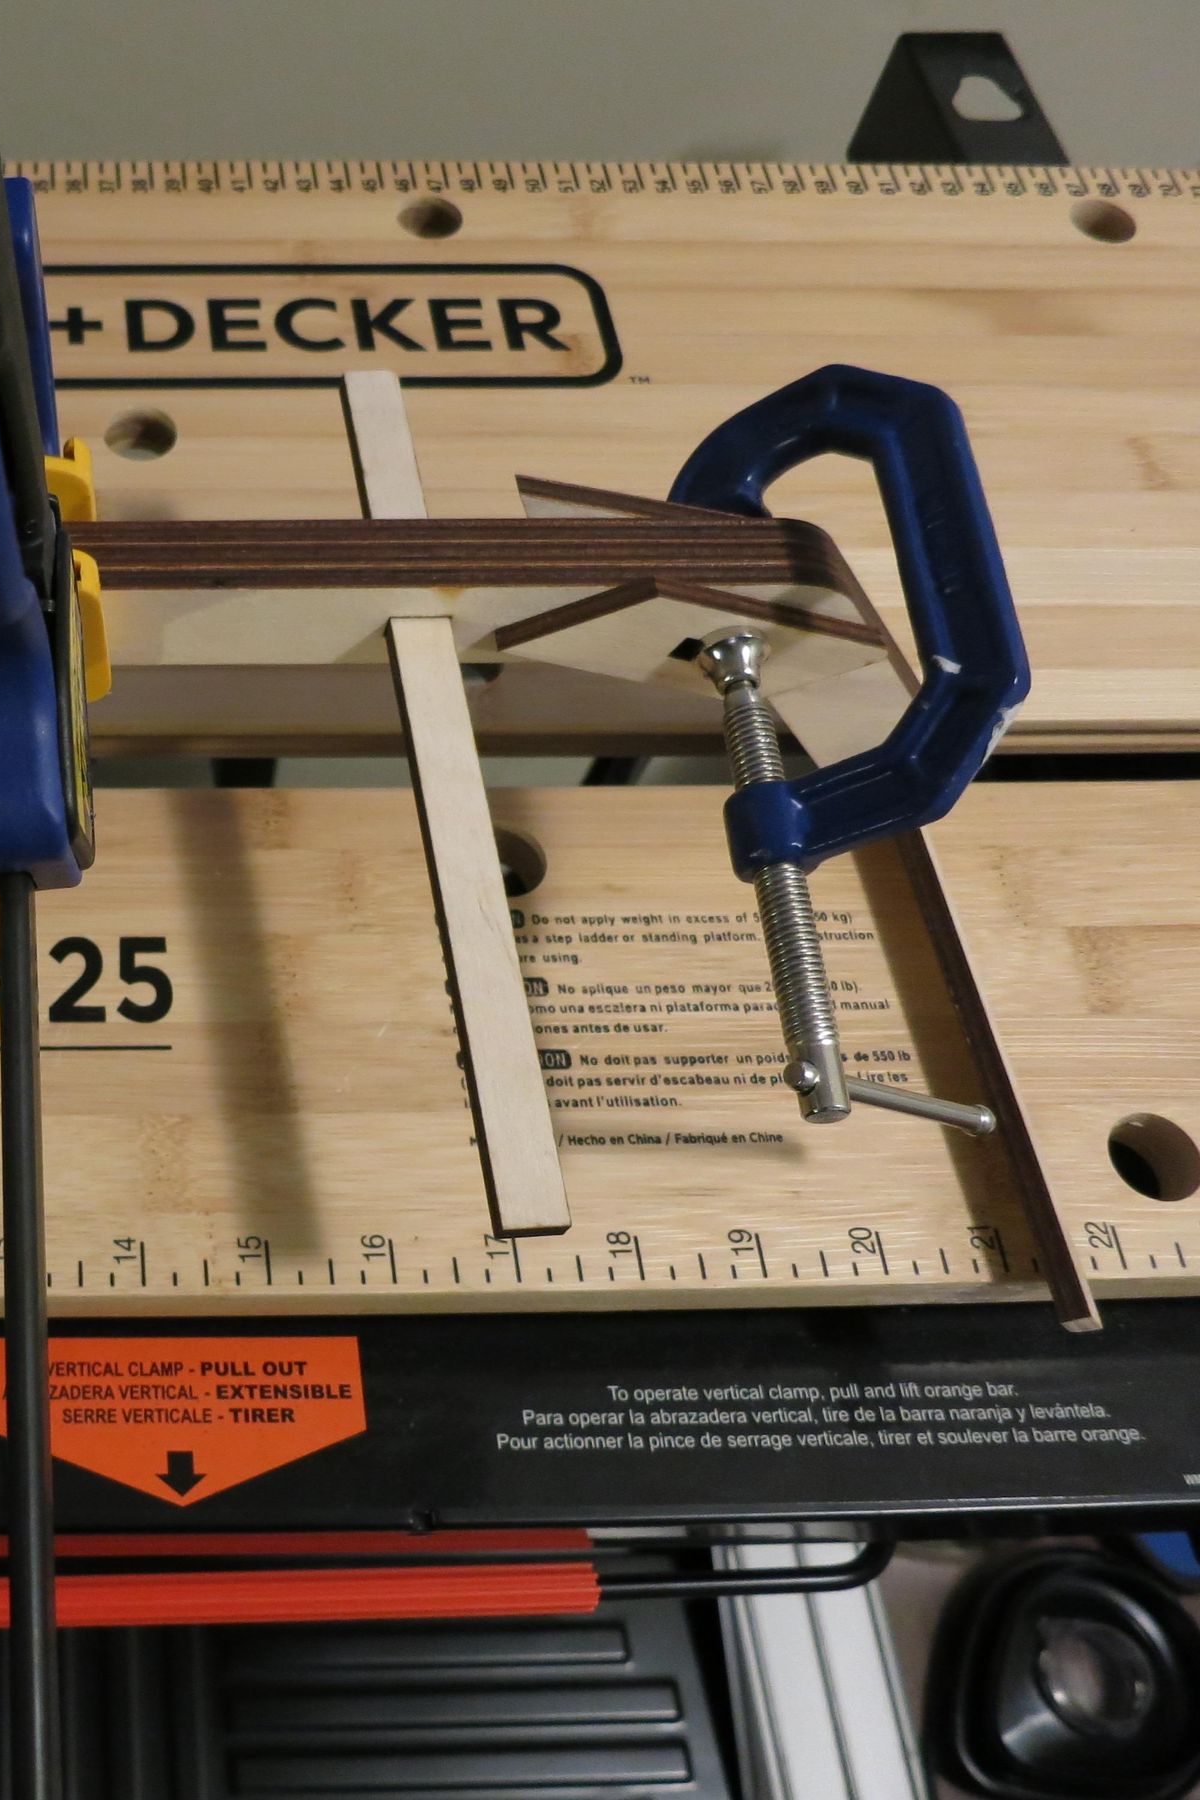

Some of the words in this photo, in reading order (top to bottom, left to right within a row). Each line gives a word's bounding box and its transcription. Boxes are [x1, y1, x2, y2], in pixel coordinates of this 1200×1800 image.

[531, 914, 549, 925] Do
[555, 914, 575, 925] not
[581, 914, 615, 927] apply
[621, 912, 663, 926] weight
[668, 914, 680, 924] in
[686, 913, 730, 924] excess
[735, 911, 748, 924] of
[545, 933, 572, 945] step
[579, 932, 618, 943] ladder
[622, 934, 634, 943] or
[642, 931, 698, 945] standing
[818, 930, 874, 941] struction
[557, 984, 575, 995] No
[582, 983, 629, 997] aplique
[635, 984, 652, 994] un
[655, 983, 685, 996] peso
[692, 982, 731, 995] mayor
[738, 983, 761, 995] que
[560, 1003, 584, 1013] una
[650, 1001, 662, 1012] ni
[666, 1000, 740, 1014] plataforma
[840, 998, 891, 1010] manual
[572, 1024, 610, 1033] antes
[614, 1023, 630, 1033] de
[579, 1055, 598, 1065] No
[604, 1054, 630, 1066] doit
[634, 1056, 657, 1067] pas
[664, 1054, 729, 1067] supporter
[736, 1055, 753, 1065] un
[546, 1076, 573, 1087] doit
[577, 1077, 602, 1089] pas
[606, 1075, 646, 1087] servir
[650, 1074, 730, 1086] d'escabeau
[733, 1075, 746, 1085] ni
[750, 1074, 766, 1085] de
[555, 1097, 593, 1108] avant
[567, 1134, 606, 1146] Hecho
[609, 1135, 626, 1146] en
[628, 1133, 661, 1145] China
[674, 1131, 728, 1146] Fabriqué
[731, 1134, 746, 1144] en
[749, 1131, 783, 1143] Chine
[113, 1236, 136, 1264] 14
[237, 1235, 261, 1262] 15
[360, 1234, 386, 1261] 16
[484, 1233, 509, 1259] 17
[606, 1231, 632, 1258] 18
[728, 1228, 754, 1256] 19
[848, 1226, 876, 1255] 20
[967, 1225, 998, 1250] 21
[1084, 1221, 1114, 1249] 22
[128, 1361, 184, 1377] CLAMP
[201, 1361, 255, 1377] PULL
[261, 1361, 307, 1377] OUT
[119, 1384, 198, 1400] VERTICAL
[216, 1384, 352, 1400] EXTENSIBLE
[607, 1386, 628, 1402] To
[634, 1386, 698, 1404] operate
[704, 1385, 763, 1401] vertical
[769, 1384, 825, 1403] clamp,
[830, 1383, 859, 1402] pull
[864, 1383, 895, 1400] and
[900, 1382, 919, 1398] lift
[924, 1383, 982, 1401] orange
[986, 1381, 1018, 1398] bar.
[62, 1407, 117, 1424] SERRE
[122, 1407, 212, 1424] VERTICALE
[229, 1407, 295, 1424] TIRER
[522, 1410, 563, 1426] Para
[569, 1411, 624, 1428] operar
[630, 1409, 645, 1425] la
[650, 1408, 747, 1425] abrazadera
[752, 1408, 819, 1425] vertical,
[823, 1406, 849, 1422] tire
[854, 1406, 876, 1422] de
[880, 1405, 896, 1421] la
[901, 1405, 945, 1421] barra
[950, 1404, 1012, 1424] naranja
[1016, 1408, 1027, 1423] y
[1030, 1403, 1111, 1419] levántela.
[497, 1433, 537, 1450] Pour
[544, 1432, 623, 1449] actionner
[628, 1433, 644, 1449] la
[649, 1433, 695, 1451] pince
[701, 1431, 721, 1448] de
[727, 1433, 792, 1451] serrage
[797, 1431, 875, 1448] verticale,
[879, 1430, 911, 1446] tirer
[917, 1430, 934, 1446] et
[939, 1428, 1008, 1445] soulever
[1012, 1428, 1028, 1443] la
[1032, 1426, 1077, 1443] barre
[1080, 1427, 1146, 1445] orange.
